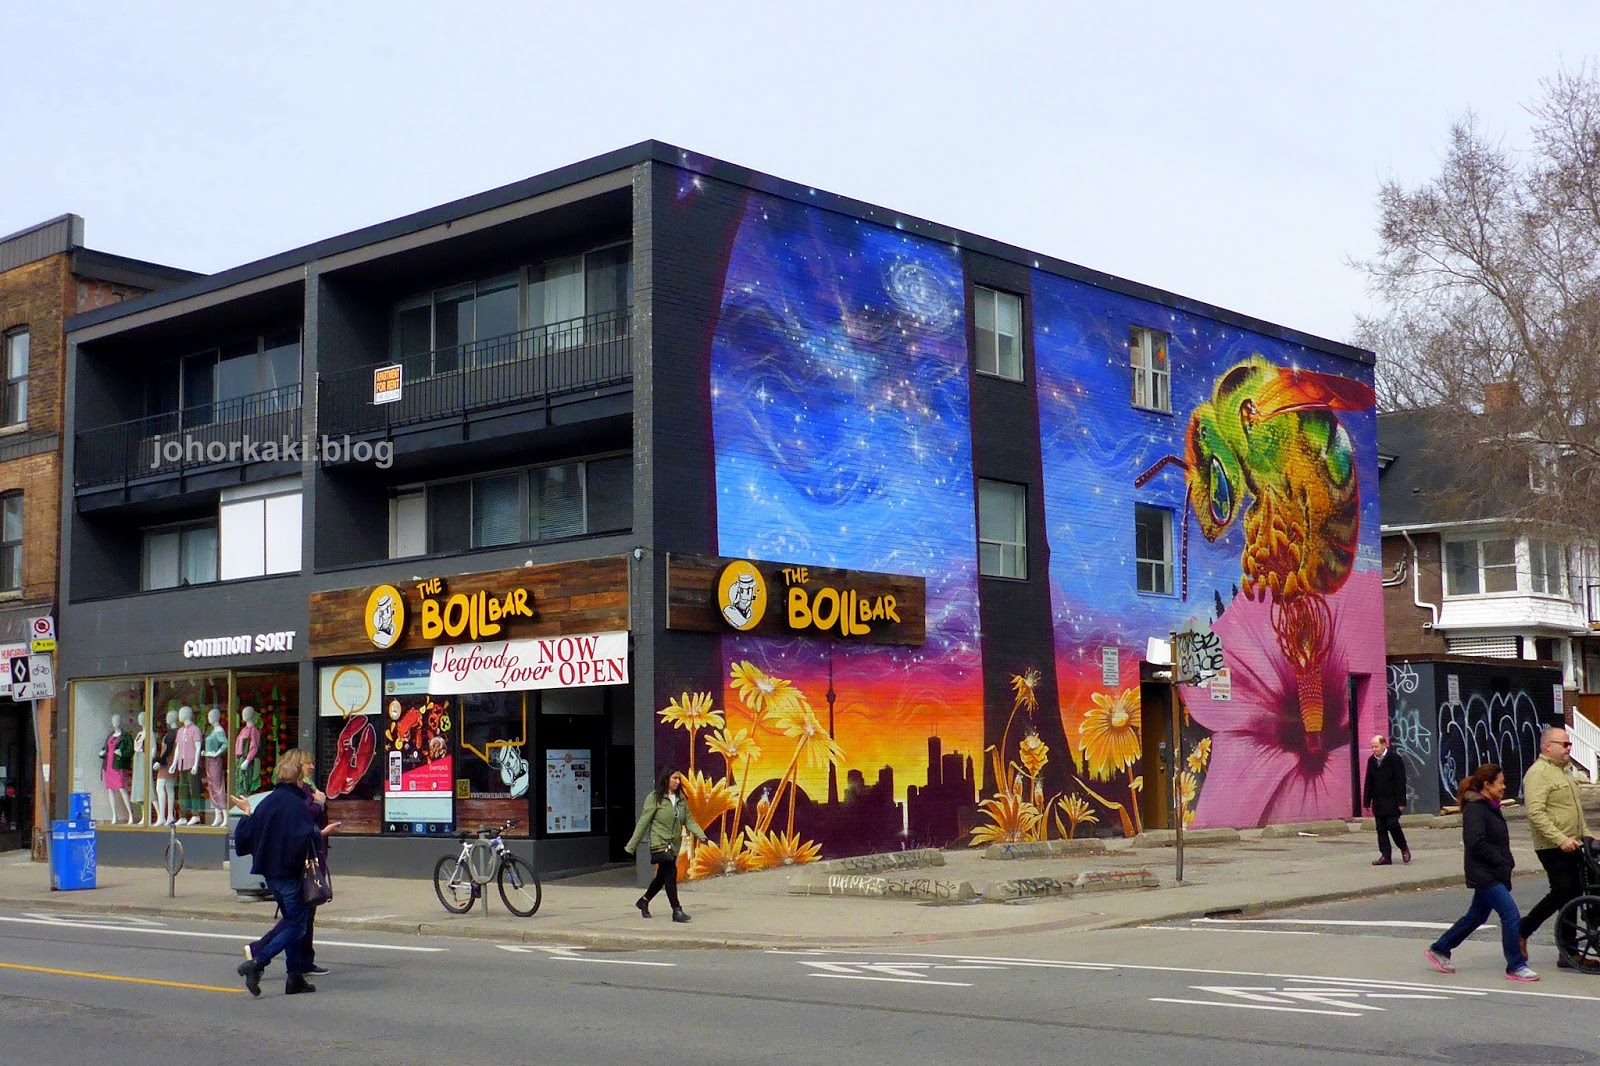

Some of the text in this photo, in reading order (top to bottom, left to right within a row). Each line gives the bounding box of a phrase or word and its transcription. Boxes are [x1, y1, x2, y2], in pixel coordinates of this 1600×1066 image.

[376, 379, 400, 393] FOR RENT
[416, 577, 442, 600] THE
[782, 567, 810, 586] THE
[421, 588, 533, 640] BOIL BAR
[788, 587, 901, 636] BOIL BAR
[254, 631, 296, 653] SORT
[537, 636, 599, 664] NOW
[433, 642, 509, 682] Seafood
[495, 656, 554, 688] Lover
[558, 657, 625, 686] OPEN
[31, 689, 48, 698] LANE
